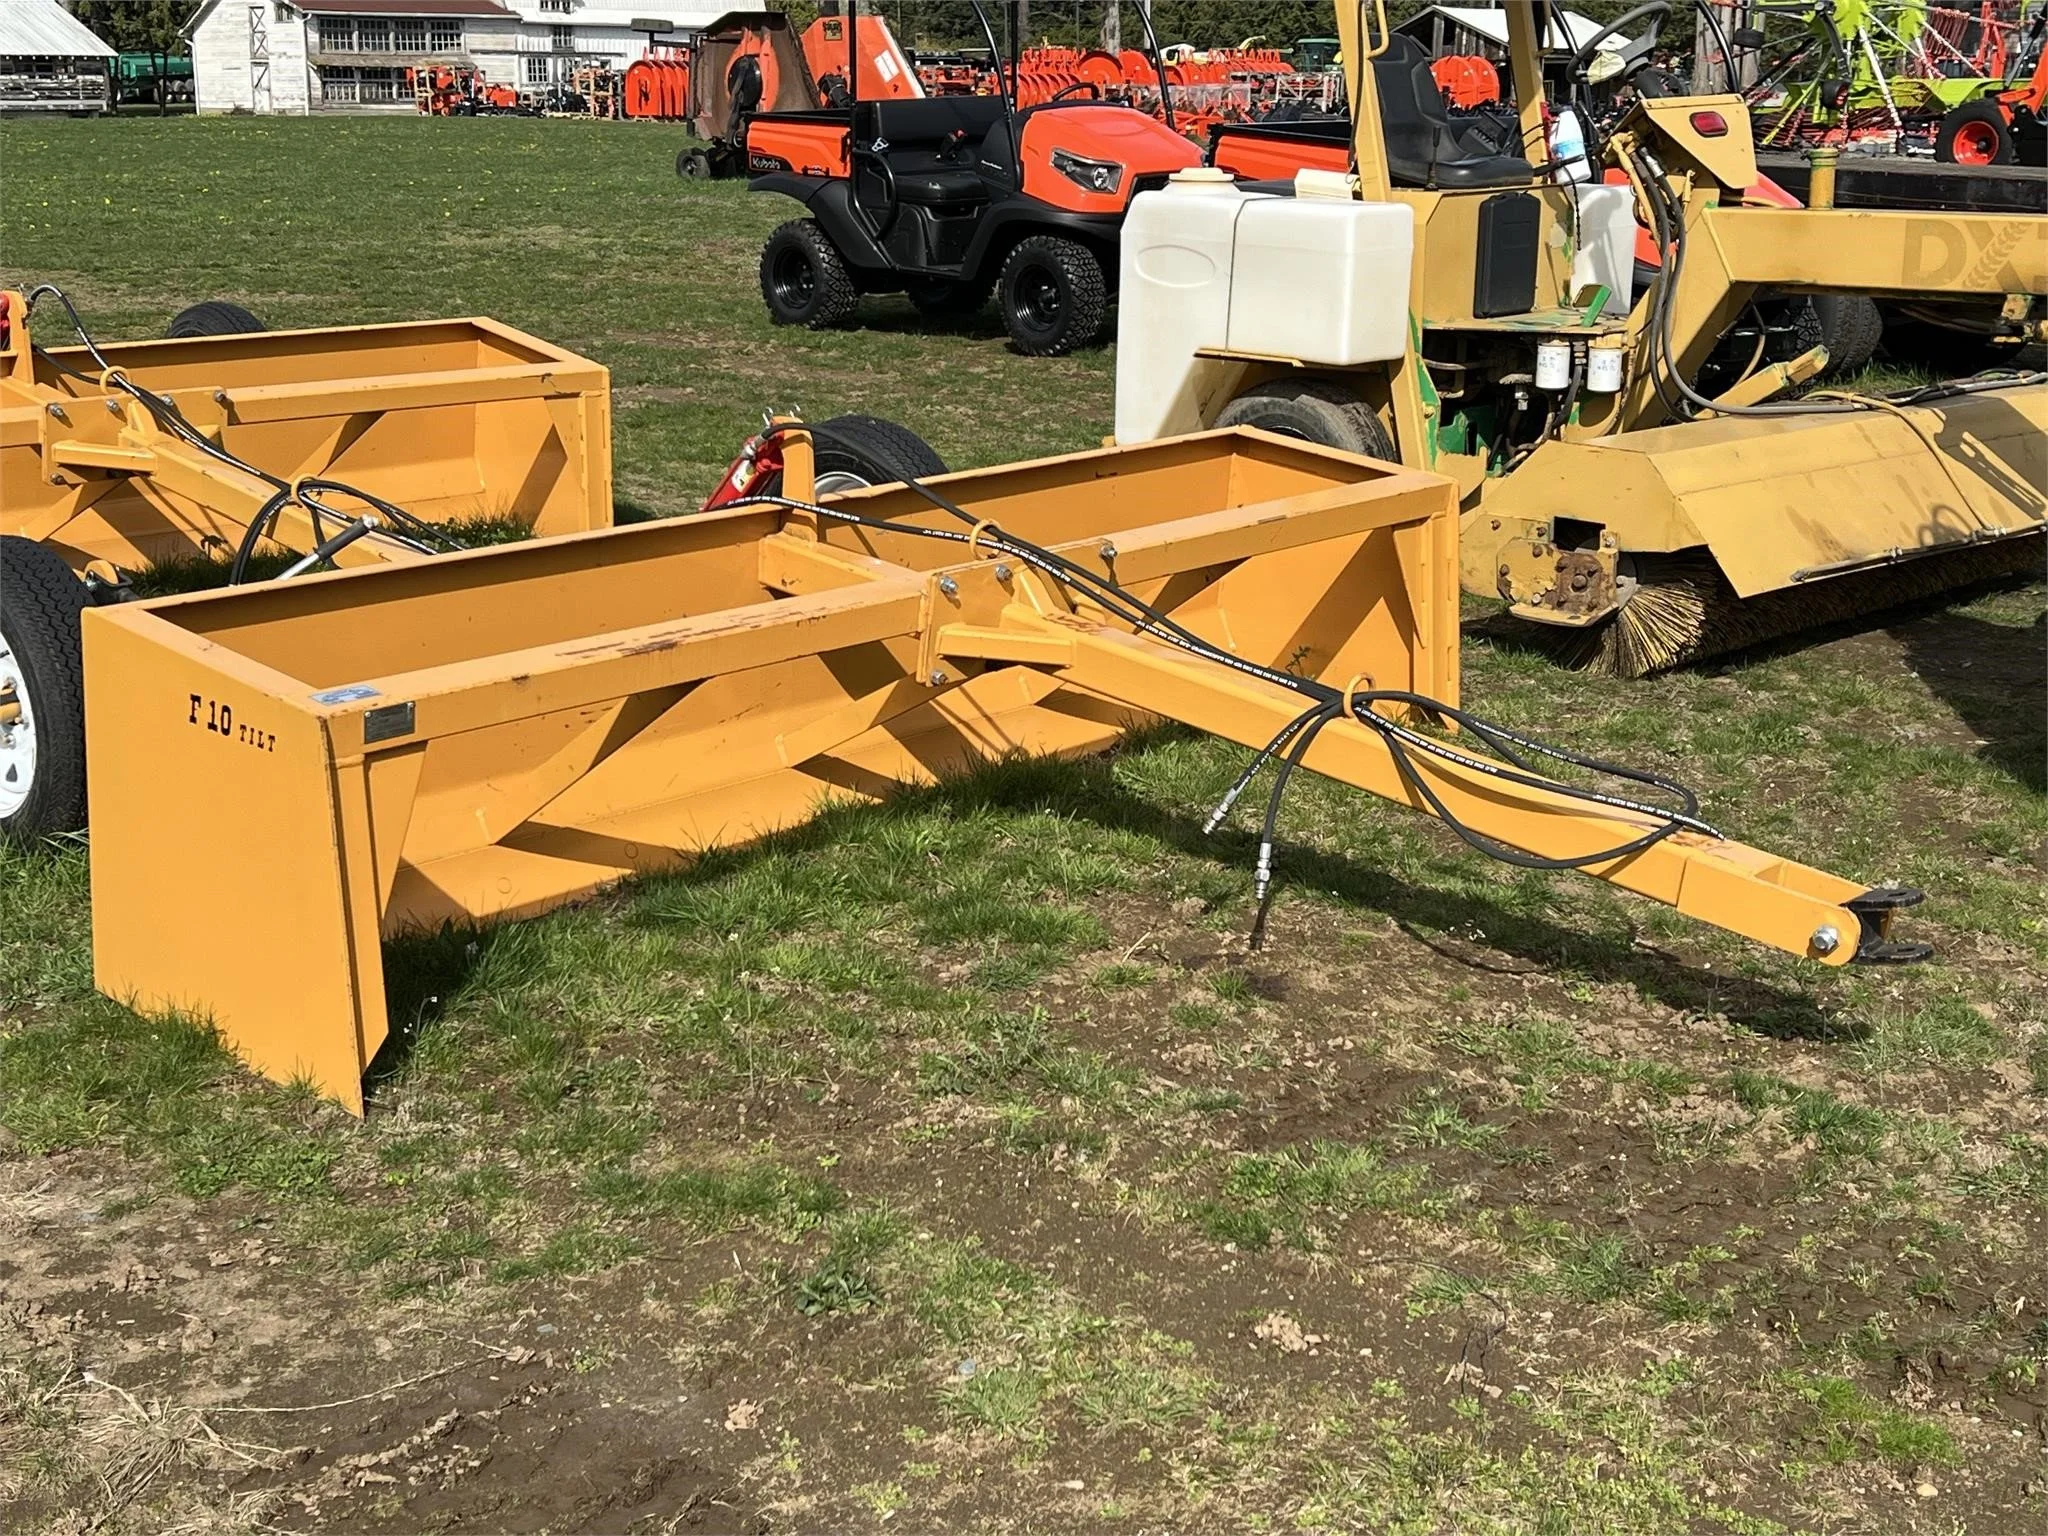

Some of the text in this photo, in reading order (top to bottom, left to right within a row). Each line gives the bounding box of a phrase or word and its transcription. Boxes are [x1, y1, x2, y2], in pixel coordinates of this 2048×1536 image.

[752, 157, 781, 170] Kubota
[1901, 219, 2048, 293] DX
[240, 724, 276, 752] TILT
